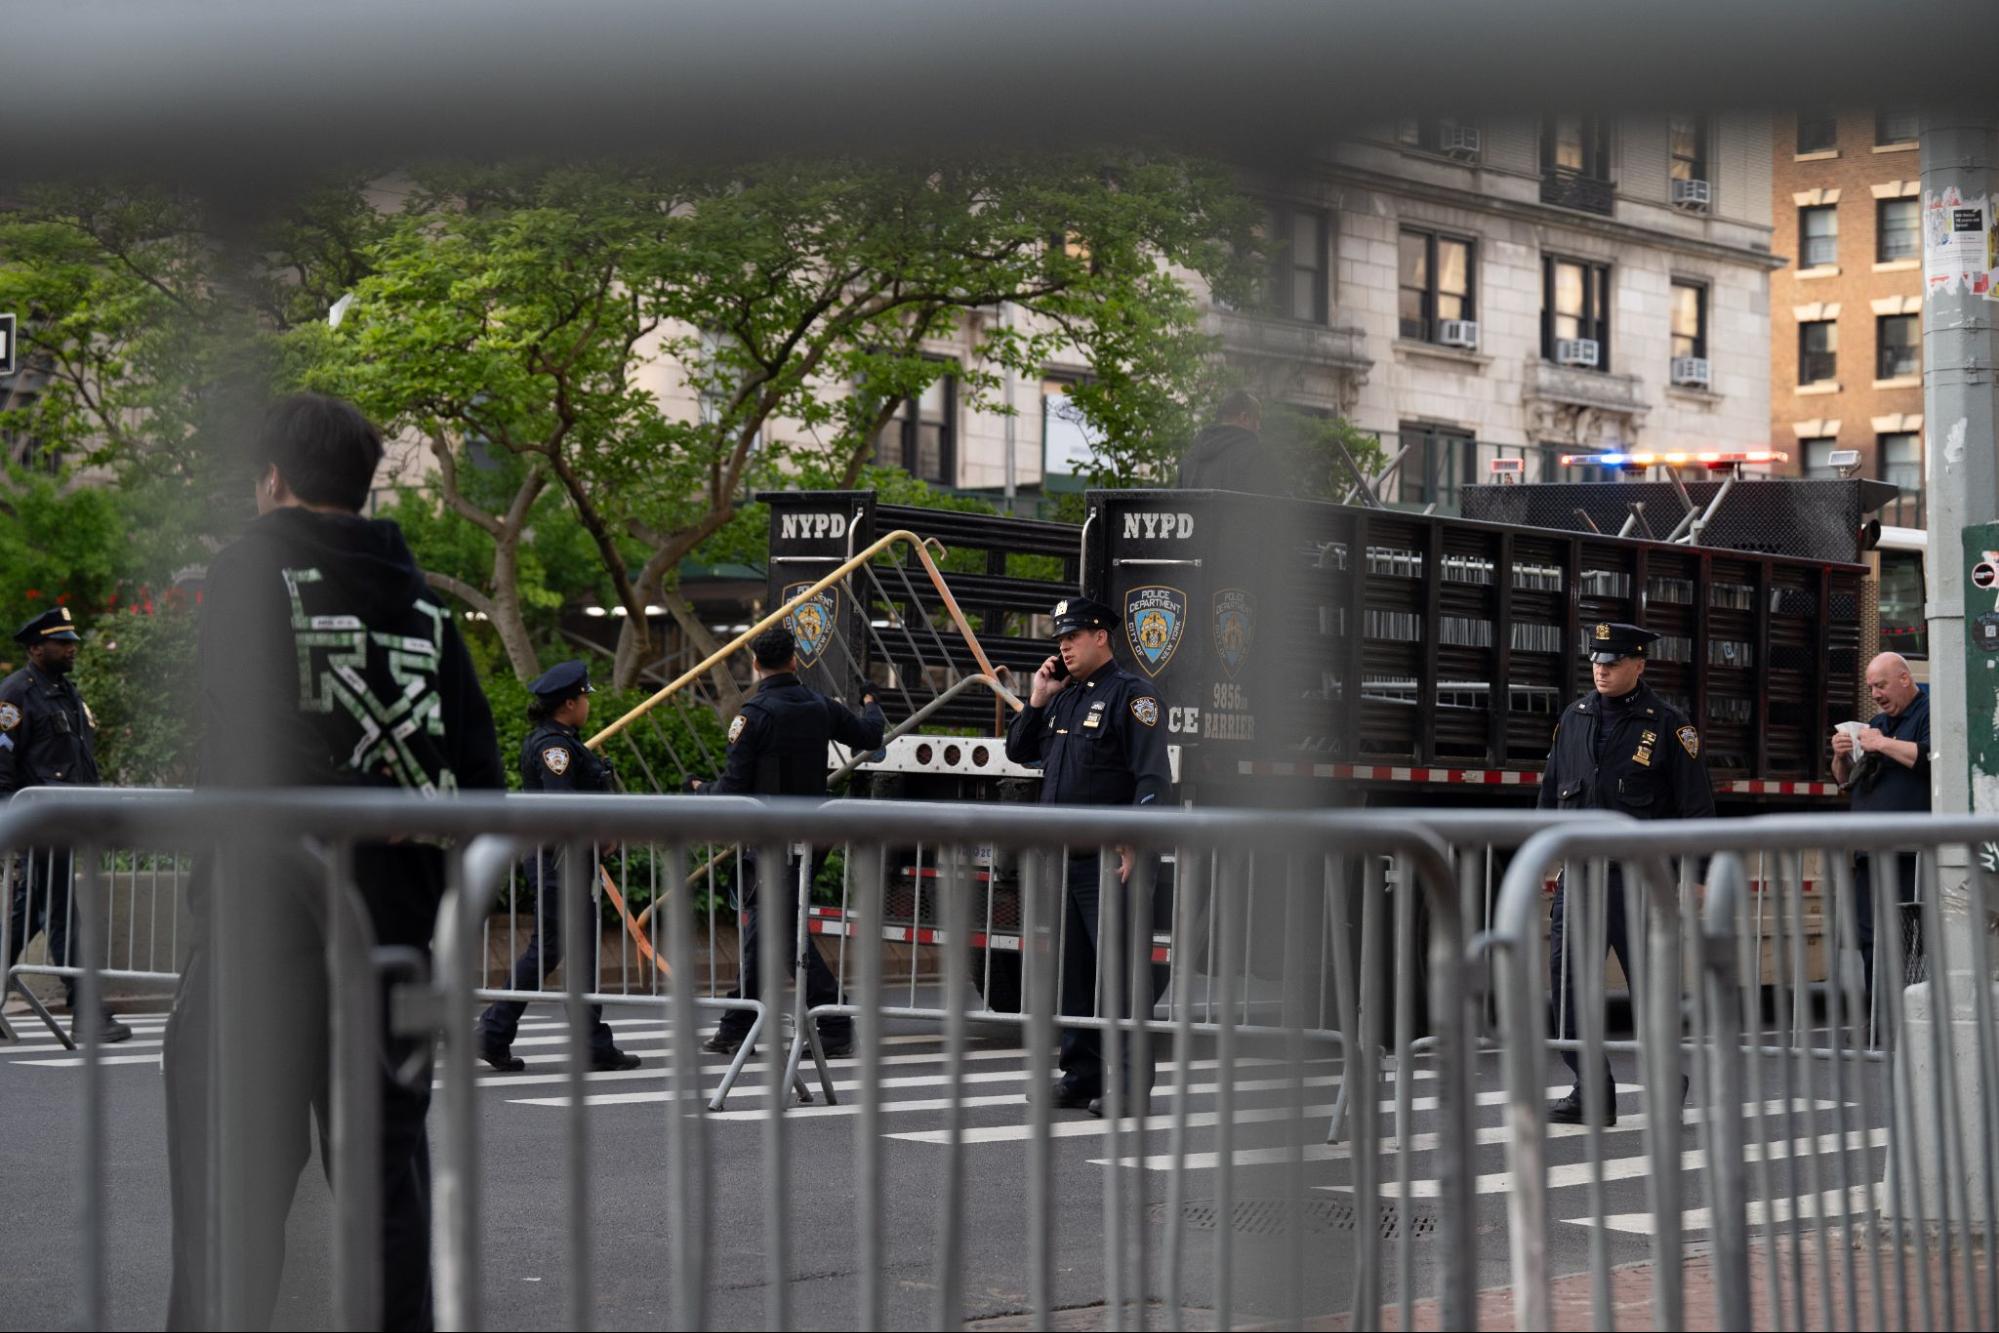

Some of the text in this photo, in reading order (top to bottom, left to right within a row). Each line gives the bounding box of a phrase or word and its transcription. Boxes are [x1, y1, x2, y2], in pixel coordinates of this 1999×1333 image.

[781, 513, 846, 538] NYPD
[1123, 512, 1194, 538] NYPD
[1129, 599, 1181, 614] DEPARTMENT
[1141, 589, 1170, 600] POLICE
[1128, 620, 1181, 661] CITY OF NEW YORK
[1203, 712, 1255, 740] BARRIER
